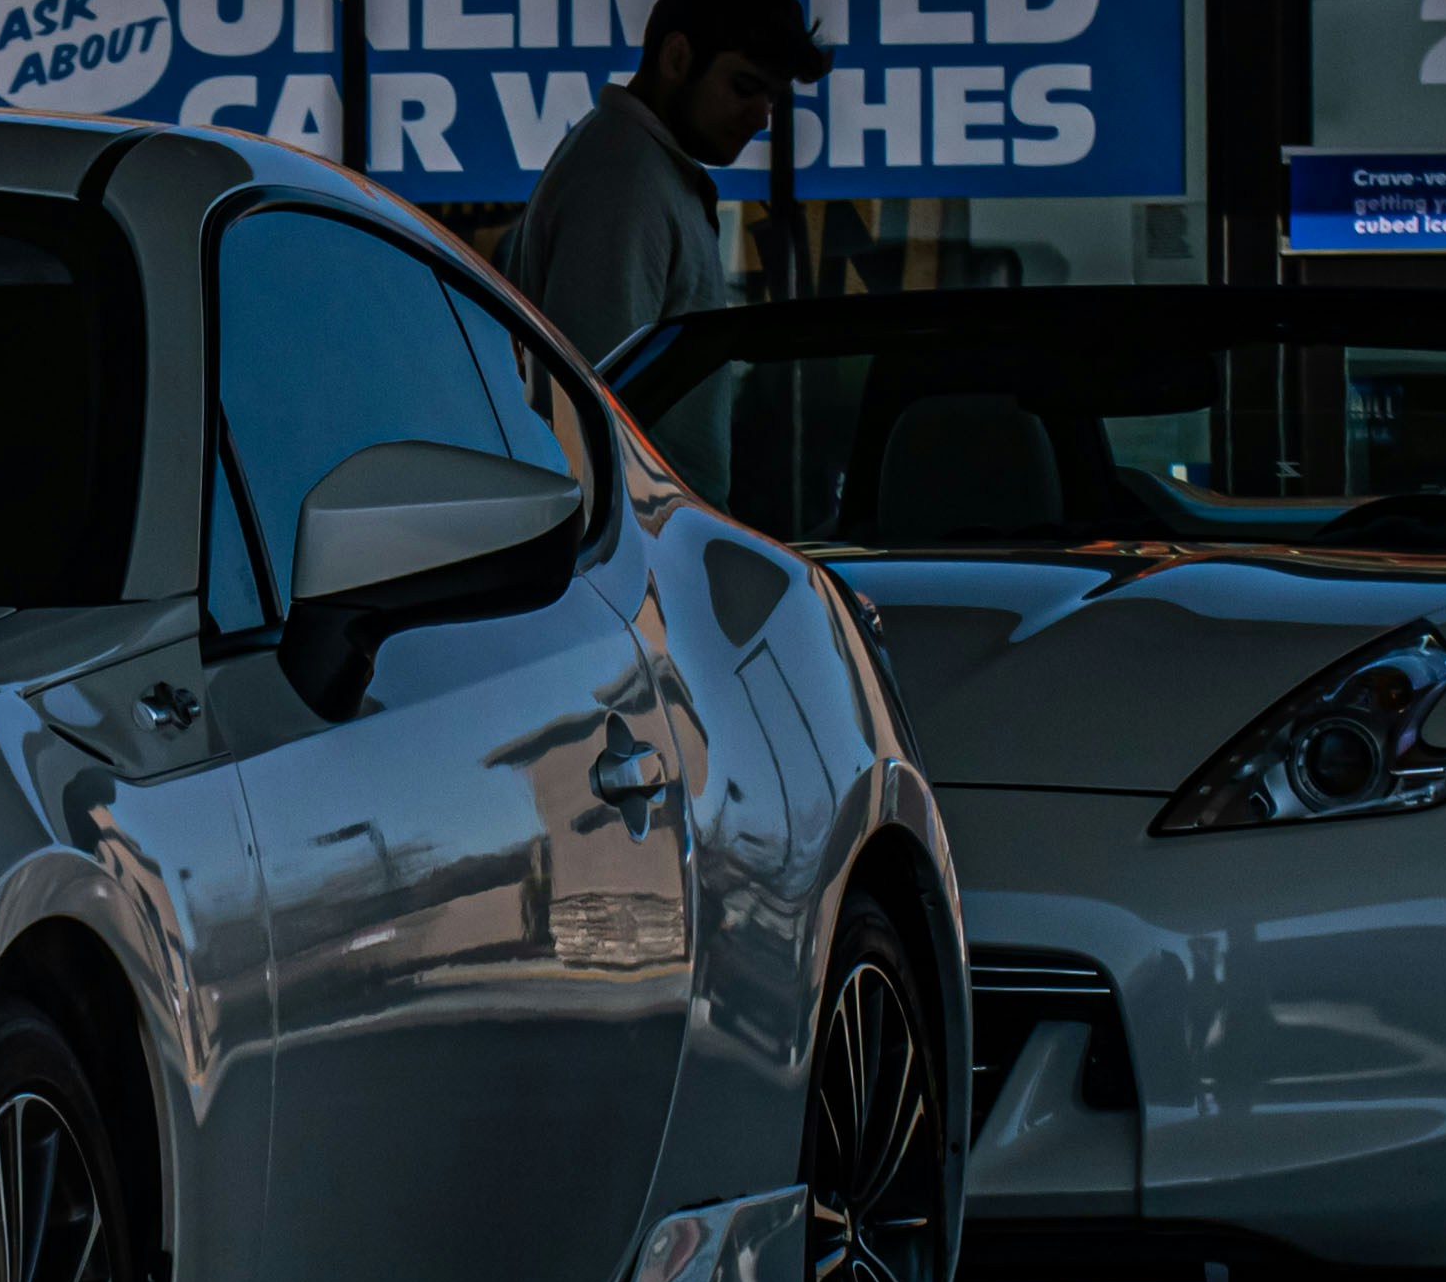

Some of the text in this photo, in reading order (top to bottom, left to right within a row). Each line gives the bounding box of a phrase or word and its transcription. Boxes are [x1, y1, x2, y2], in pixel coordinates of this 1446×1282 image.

[9, 17, 168, 94] ABOUT
[1354, 193, 1428, 216] getting
[1354, 216, 1420, 235] cubed
